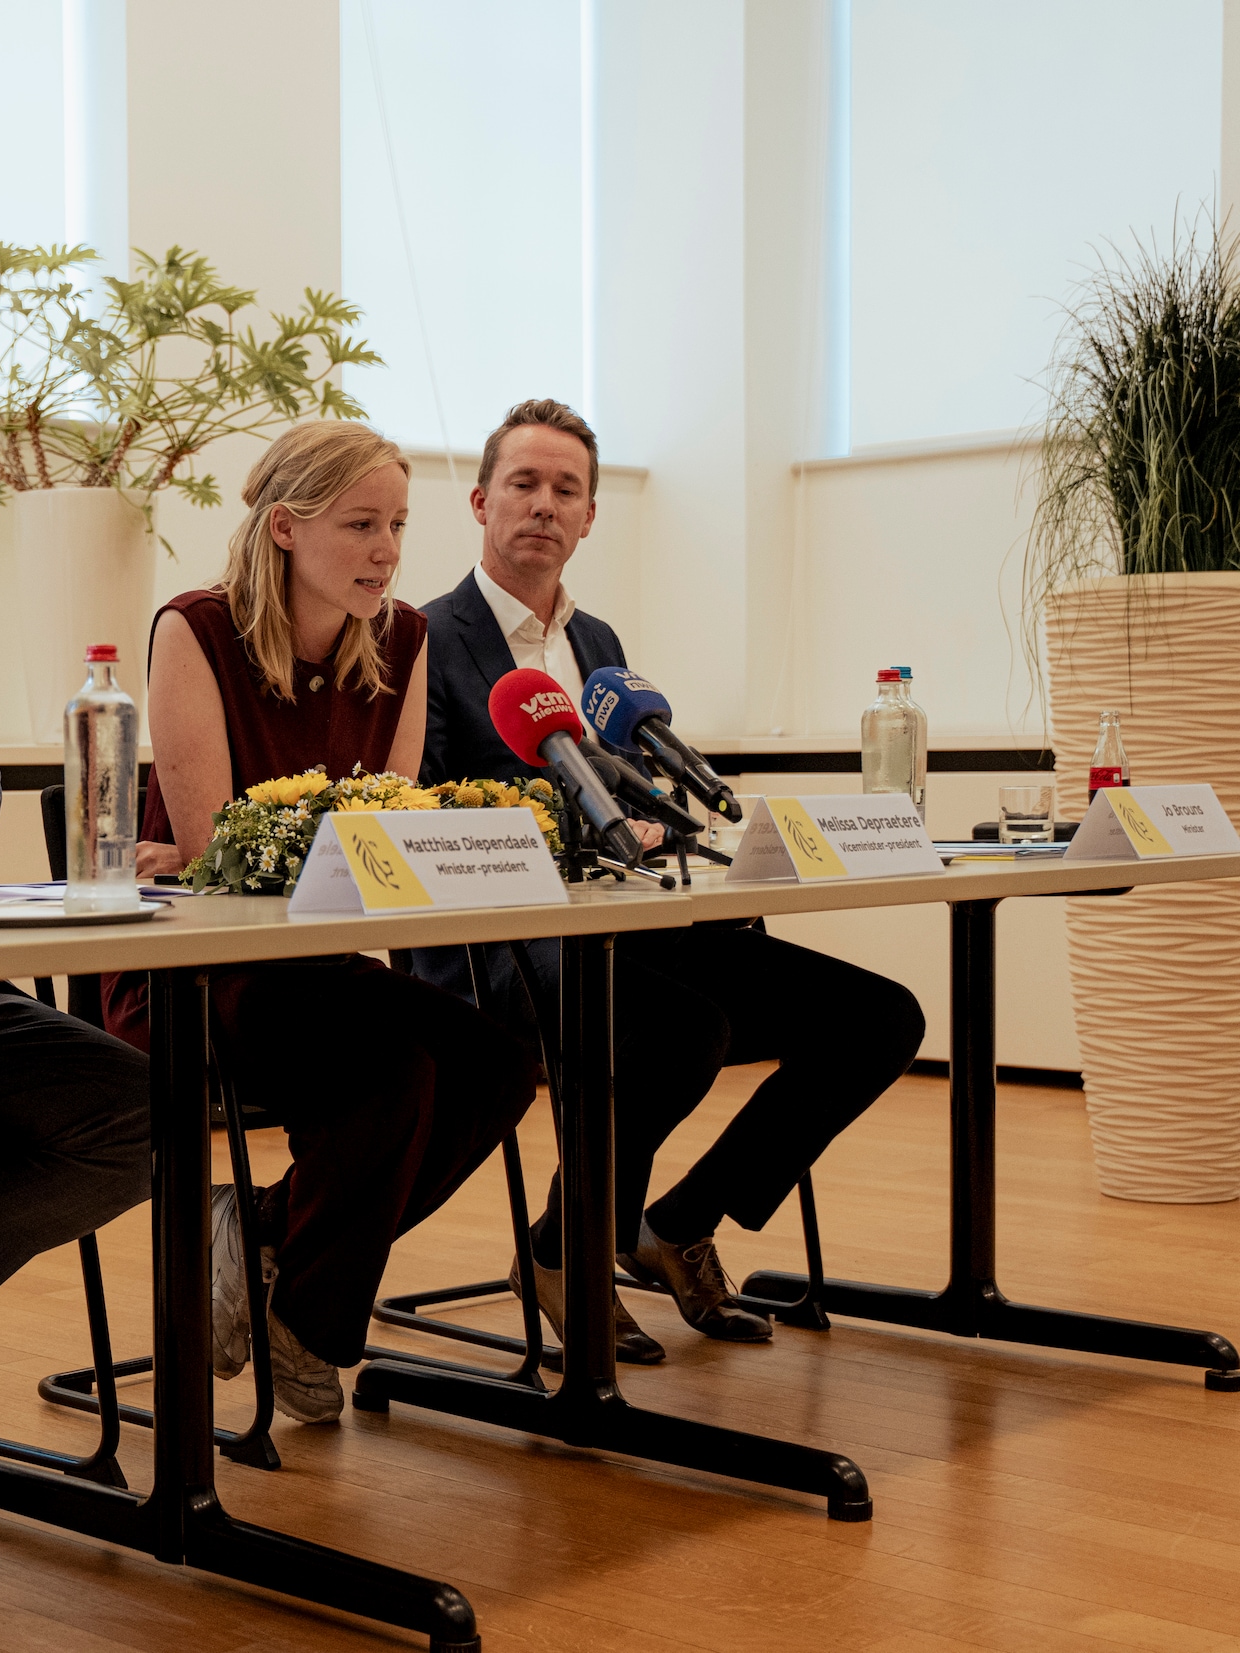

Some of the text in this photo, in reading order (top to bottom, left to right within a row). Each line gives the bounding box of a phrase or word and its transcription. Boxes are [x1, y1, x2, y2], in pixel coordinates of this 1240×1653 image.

[519, 692, 571, 714] vtm
[586, 682, 606, 714] vrt
[597, 695, 615, 726] nws
[1172, 804, 1204, 816] Brouns
[817, 815, 921, 833] Melissa Depraetere
[403, 834, 539, 854] Matthias Diependaele
[839, 838, 922, 852] Viceminister-president
[436, 860, 529, 877] Minister-president
